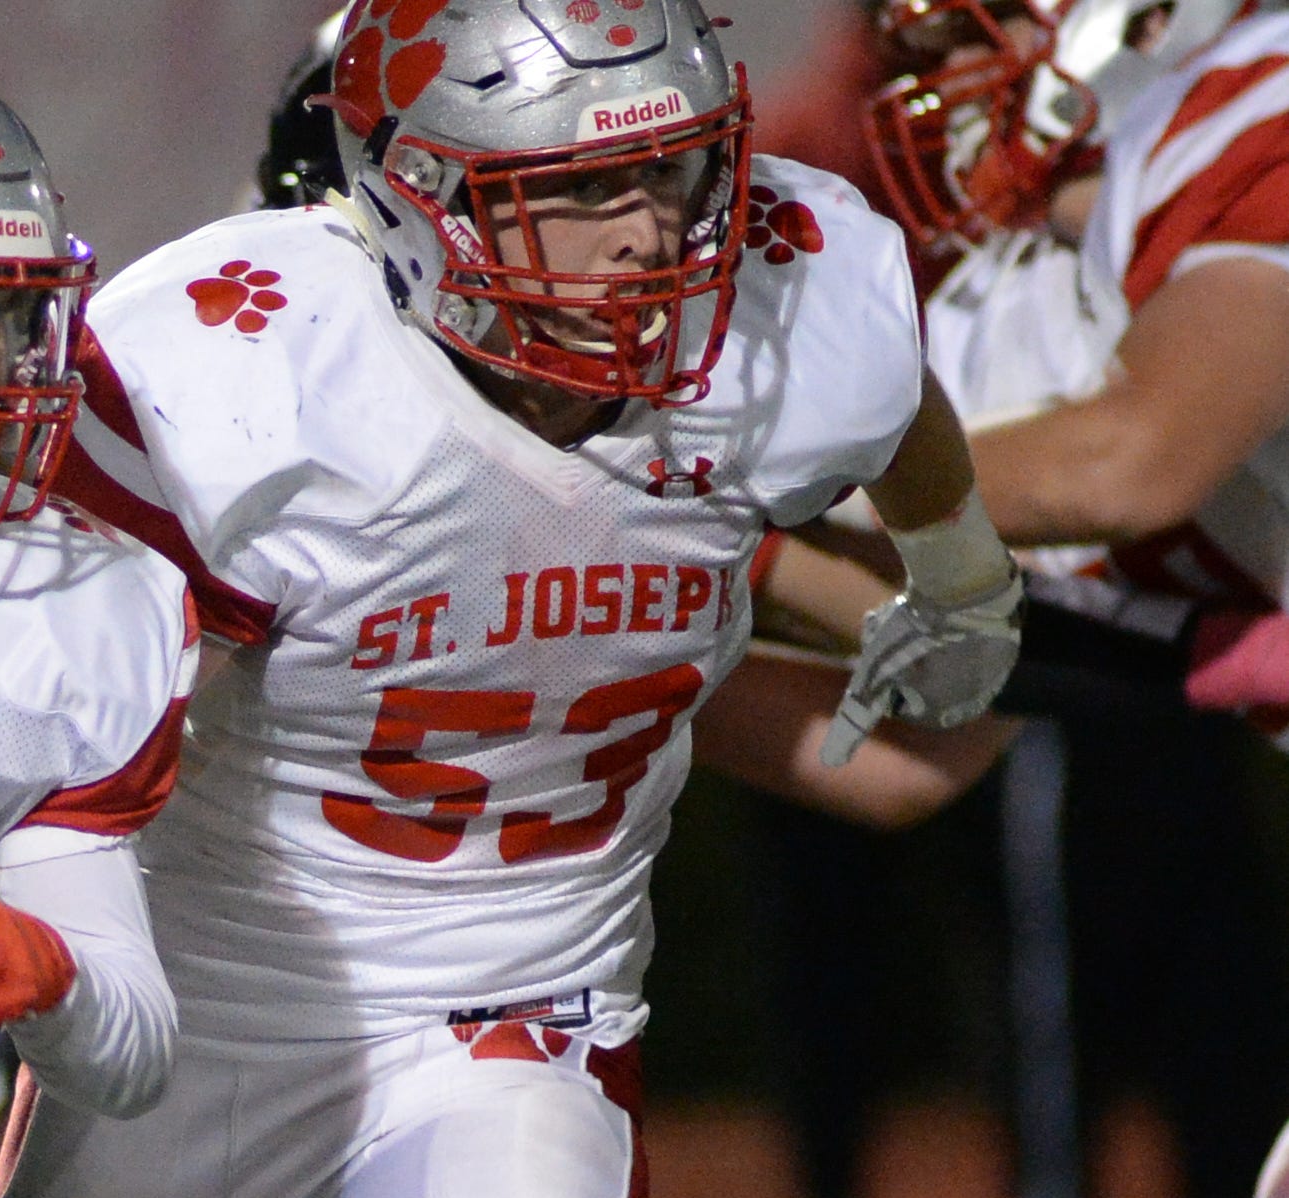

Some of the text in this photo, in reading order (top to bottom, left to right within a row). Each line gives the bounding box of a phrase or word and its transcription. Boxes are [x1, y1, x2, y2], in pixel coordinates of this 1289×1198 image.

[594, 93, 681, 132] Riddell
[350, 592, 457, 670] ST.
[321, 663, 703, 863] 53
